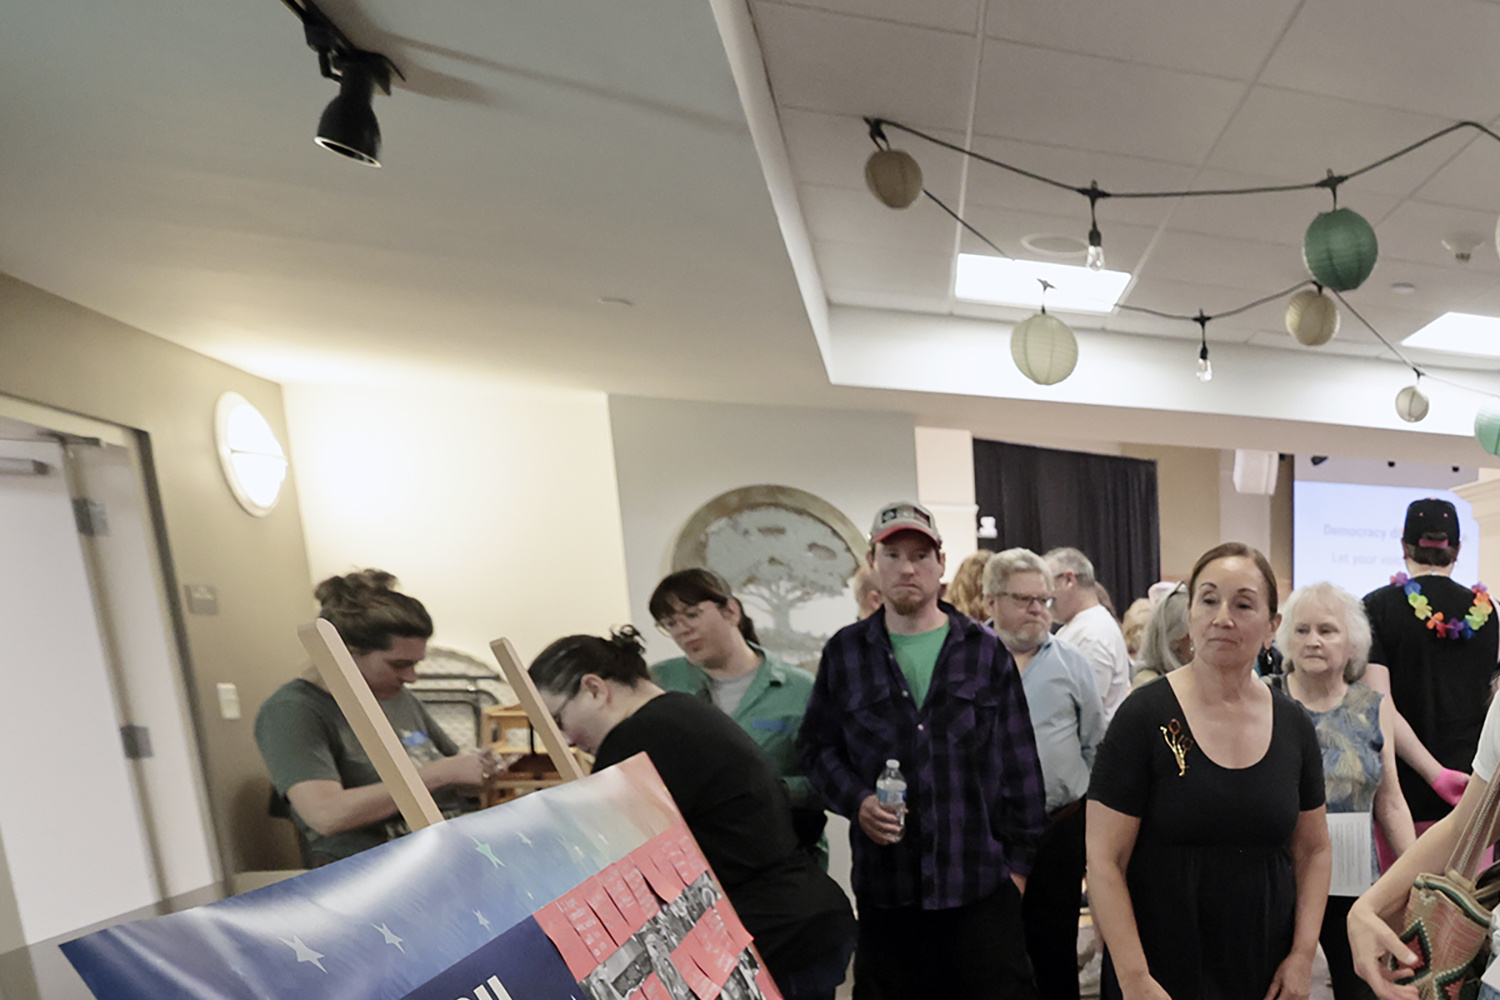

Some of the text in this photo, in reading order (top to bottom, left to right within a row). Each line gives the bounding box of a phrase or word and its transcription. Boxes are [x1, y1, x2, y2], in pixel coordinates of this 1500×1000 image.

[1323, 523, 1387, 540] Democracy
[1331, 551, 1350, 563] Let
[1352, 554, 1377, 566] your
